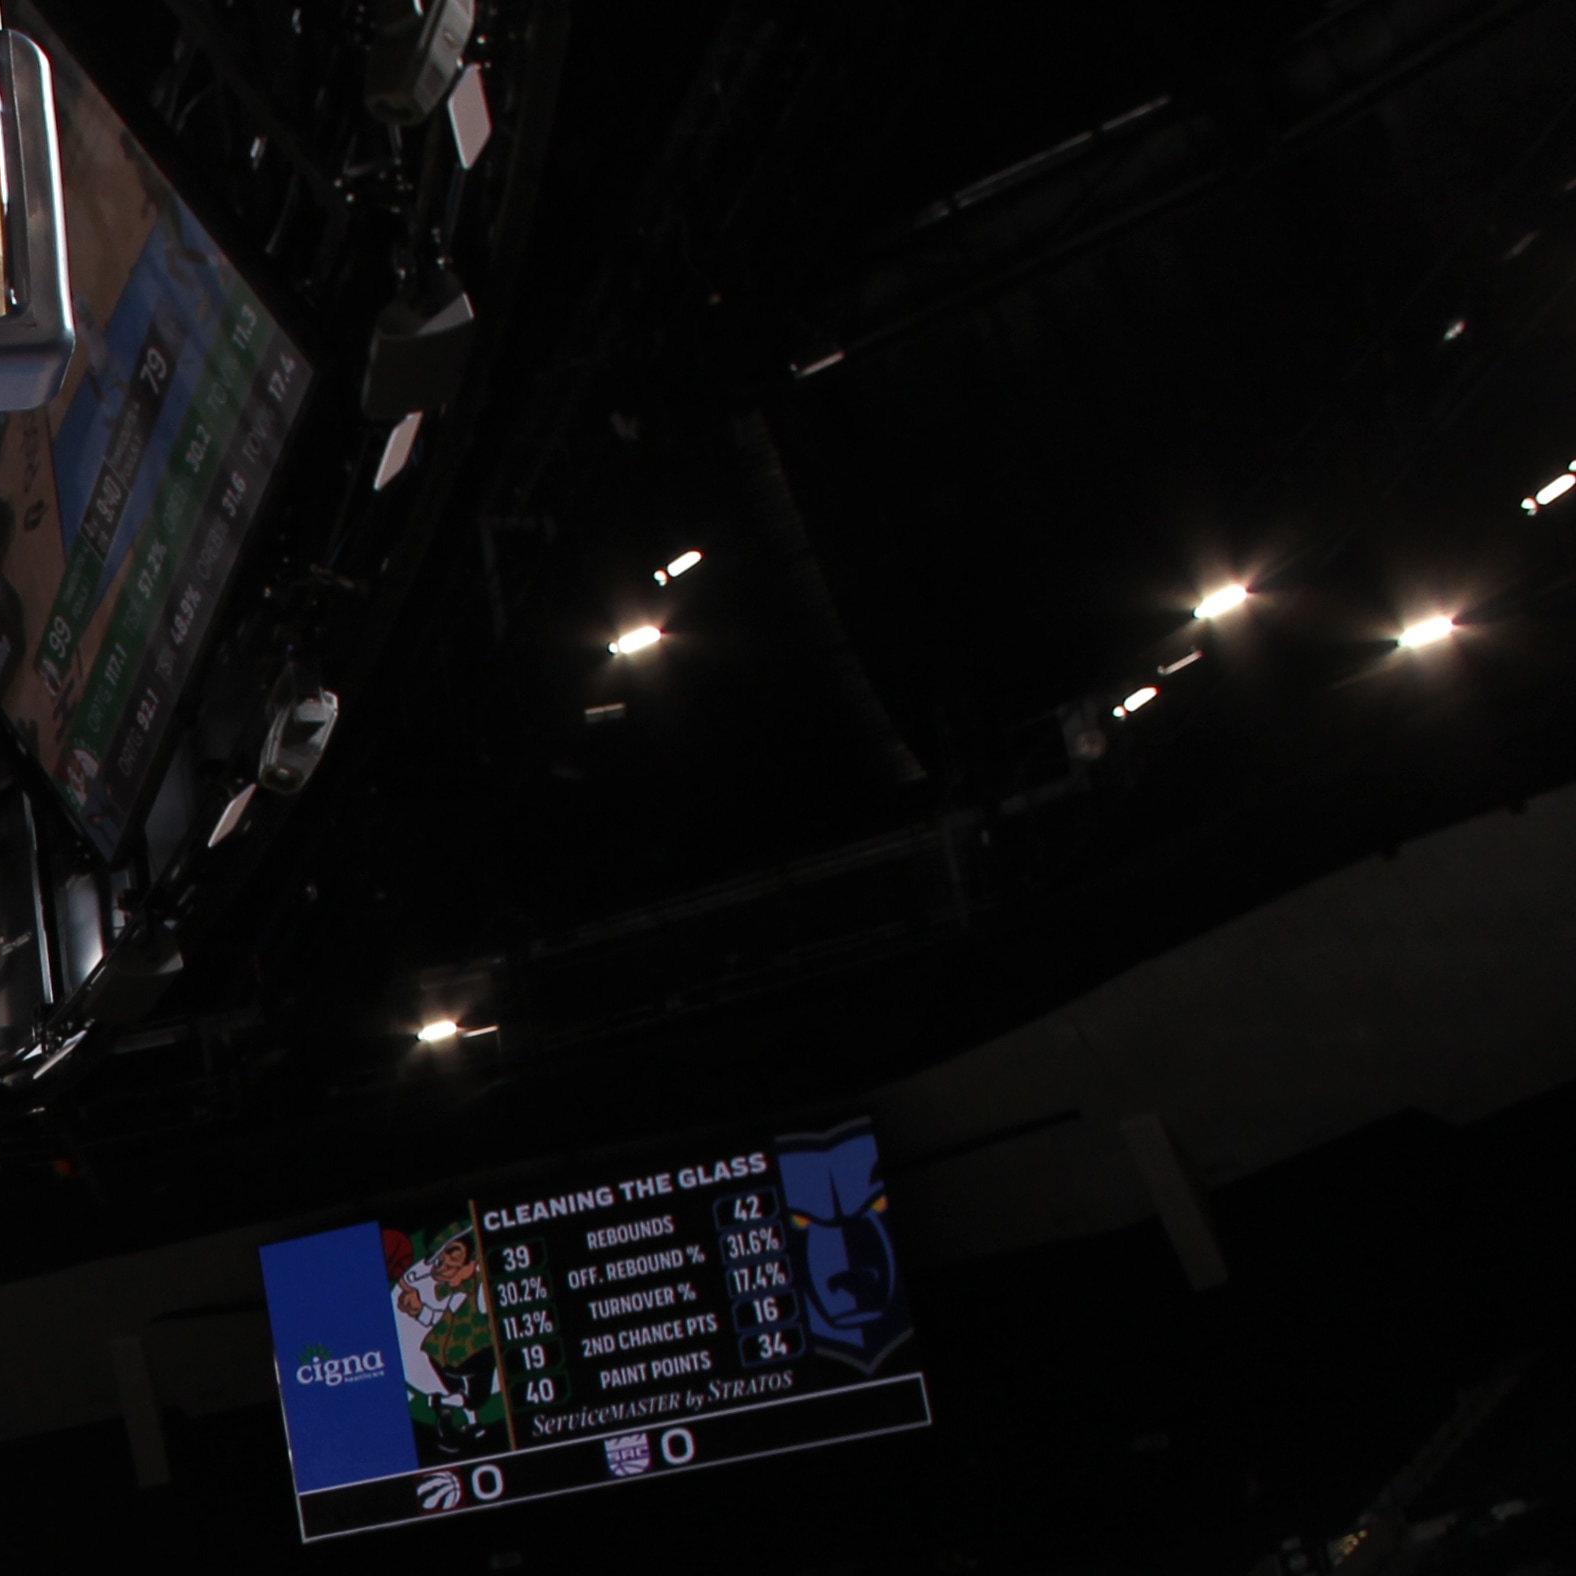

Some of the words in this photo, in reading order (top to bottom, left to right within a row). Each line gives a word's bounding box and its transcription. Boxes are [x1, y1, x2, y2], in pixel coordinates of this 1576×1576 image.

[139, 346, 168, 394] 79
[48, 617, 71, 657] 99
[136, 688, 160, 731] 92.1
[483, 1185, 616, 1232] CLEANING
[618, 1172, 673, 1203] THE
[677, 1152, 769, 1189] GLASS
[497, 1275, 548, 1307] 30.2%
[567, 1268, 604, 1290] OFF.
[606, 1250, 683, 1282] REBOUND
[686, 1245, 705, 1265] %
[726, 1227, 780, 1260] 31.6%
[502, 1245, 531, 1272] 39
[586, 1215, 675, 1250] REBOUNDS
[733, 1194, 764, 1222] 42
[503, 1310, 553, 1341] 11.3%
[588, 1286, 675, 1321] TURNOVER
[677, 1282, 697, 1302] %
[733, 1261, 786, 1294] 17.4%
[521, 1344, 546, 1370] 19
[581, 1336, 615, 1359] 2ND
[618, 1321, 684, 1350] CHANCE
[686, 1312, 718, 1336] PTS
[753, 1296, 779, 1324] 16
[296, 1351, 385, 1387] cigna
[525, 1378, 555, 1404] 40
[600, 1363, 647, 1390] PAINT
[650, 1349, 713, 1380] POINTS
[757, 1331, 789, 1360] 34
[685, 1388, 705, 1408] by
[707, 1370, 795, 1402] STRATOS
